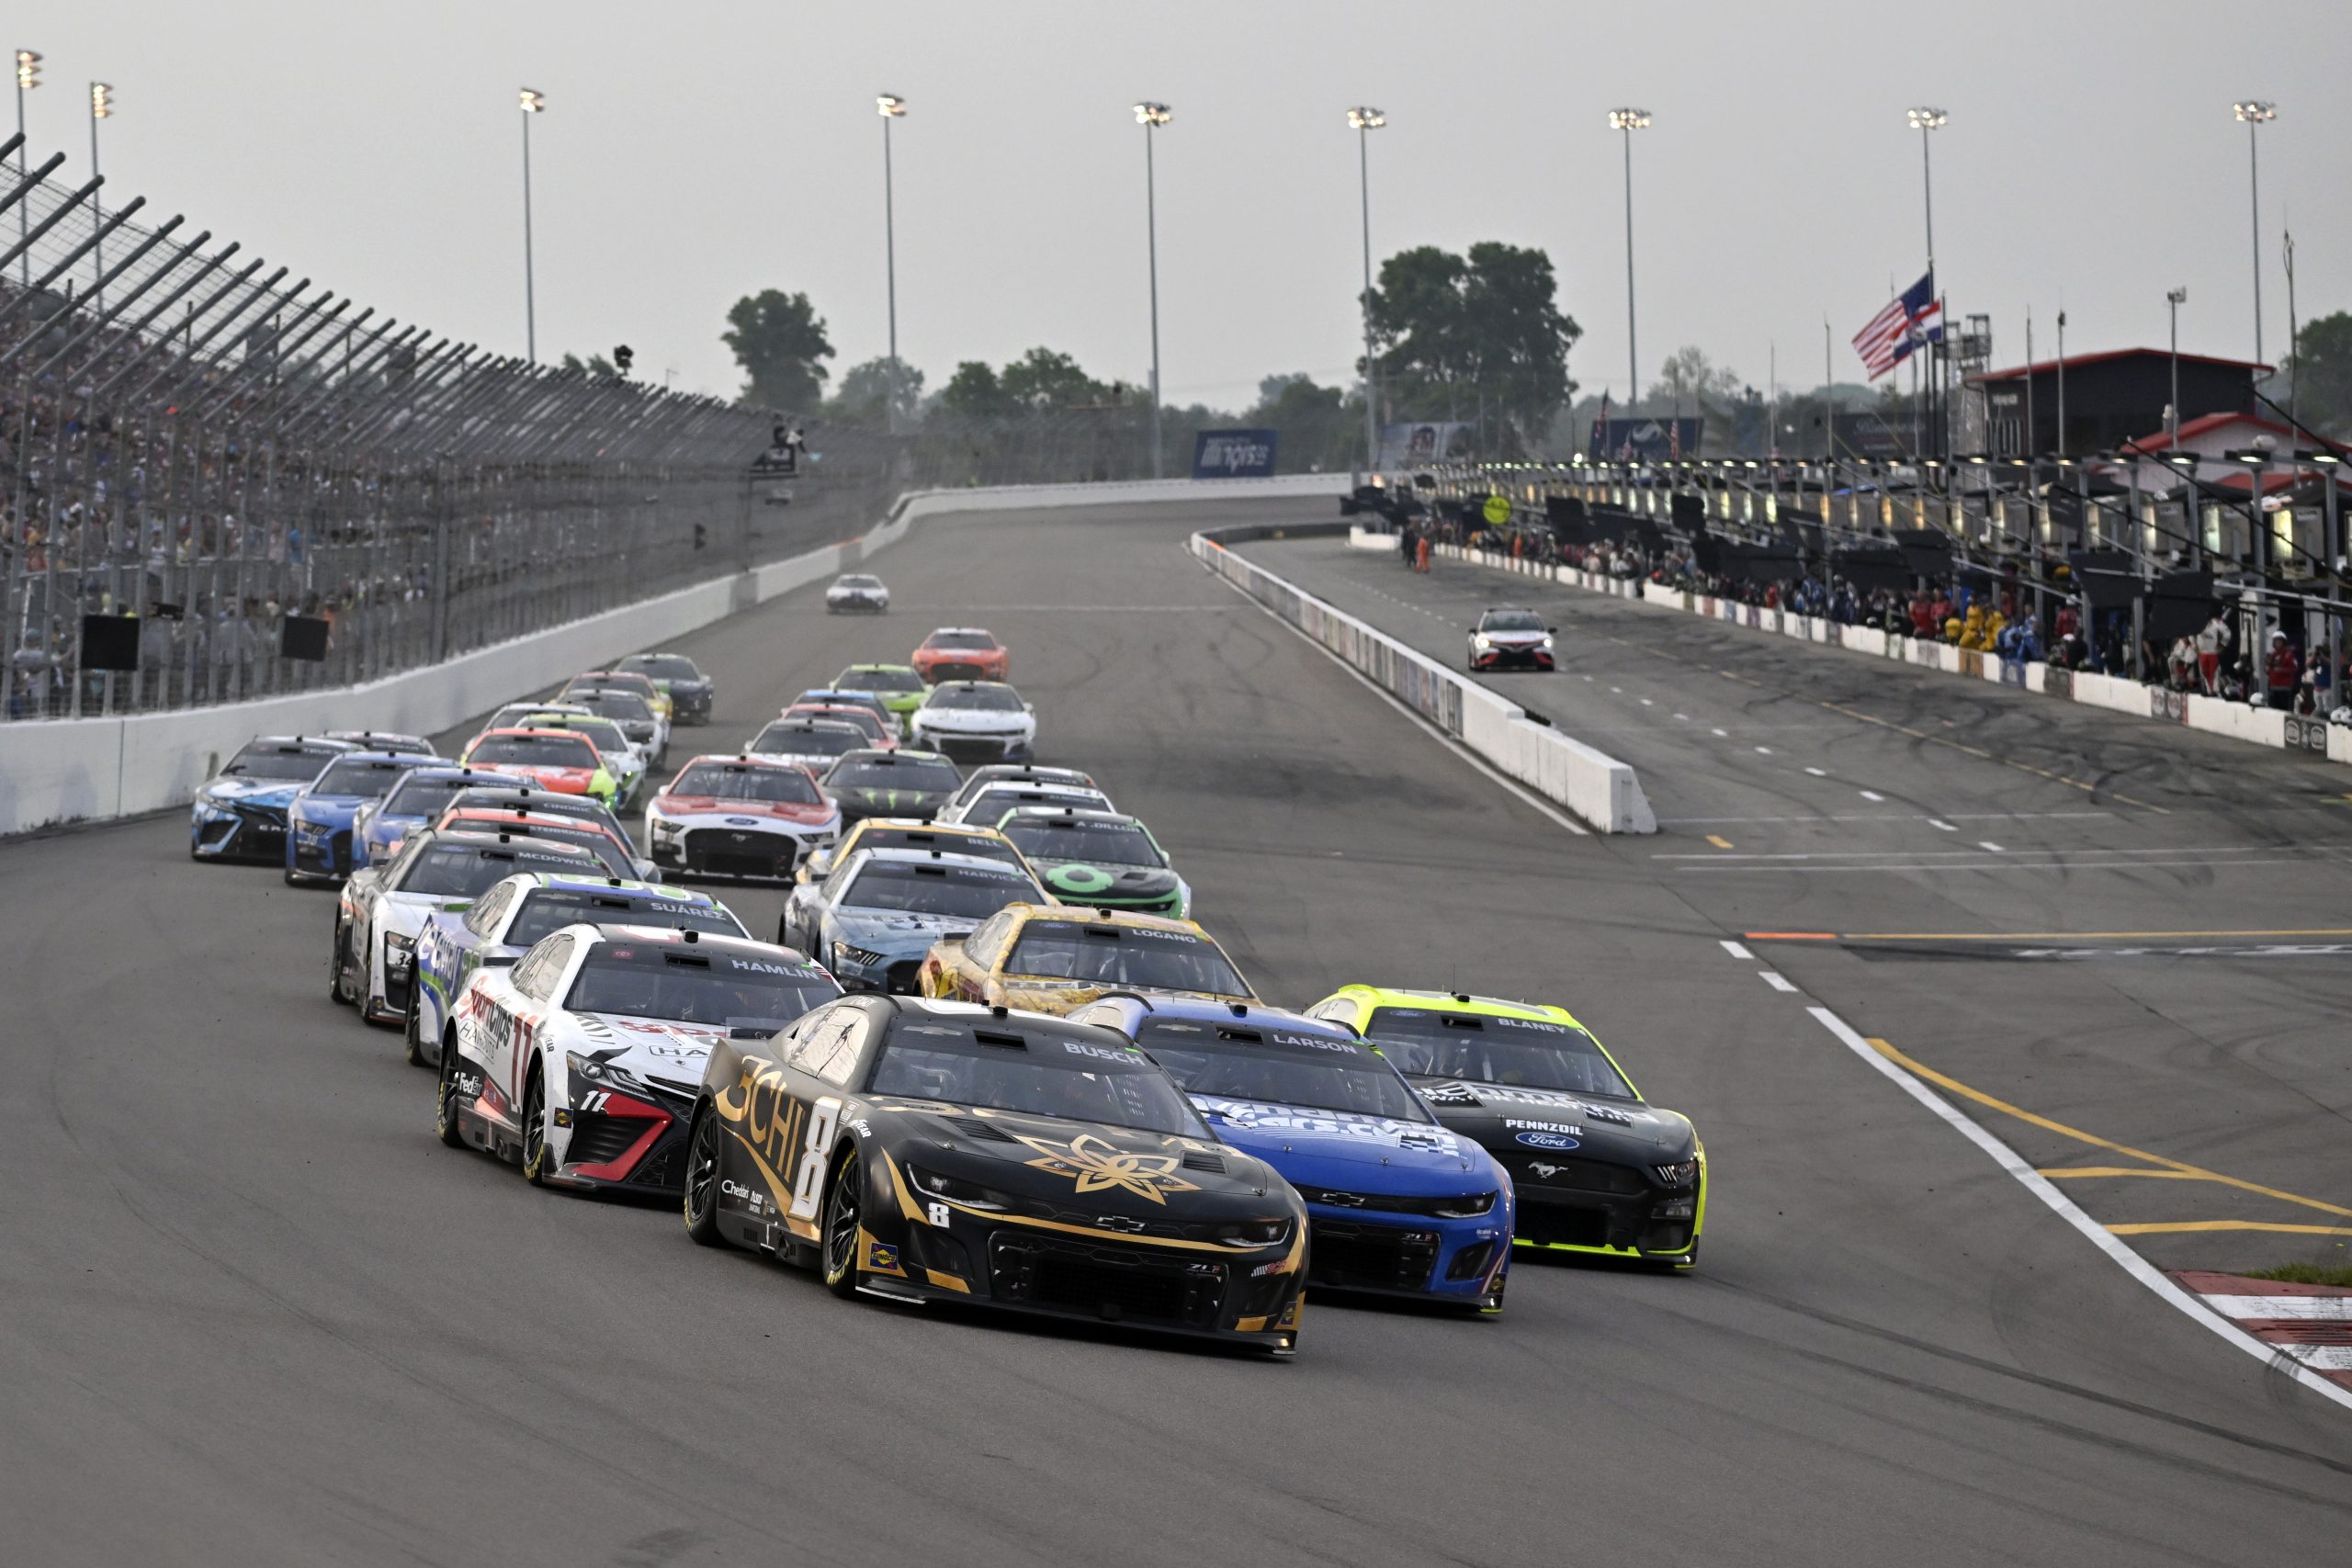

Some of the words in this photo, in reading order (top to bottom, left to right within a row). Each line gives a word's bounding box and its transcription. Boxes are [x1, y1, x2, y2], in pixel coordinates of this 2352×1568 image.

[544, 803, 591, 813] CINDRIC
[529, 825, 593, 839] STENHOUSE
[967, 837, 1001, 847] BELL
[518, 852, 596, 868] MCDOWELL
[958, 869, 1019, 882] HARVICK
[1133, 929, 1197, 944] LOGANO
[731, 959, 820, 980] HAMLIN
[1498, 1017, 1566, 1034] BLANEY
[1272, 1033, 1358, 1055] LARSON
[1063, 1043, 1147, 1066] BUSCH
[459, 1072, 482, 1095] FedEx
[580, 1090, 612, 1112] 11
[1505, 1119, 1584, 1136] PENNZOIL
[1528, 1133, 1567, 1146] Ford
[786, 1096, 842, 1222] 8
[928, 1201, 951, 1228] 8
[871, 1251, 897, 1263] SUNOCO
